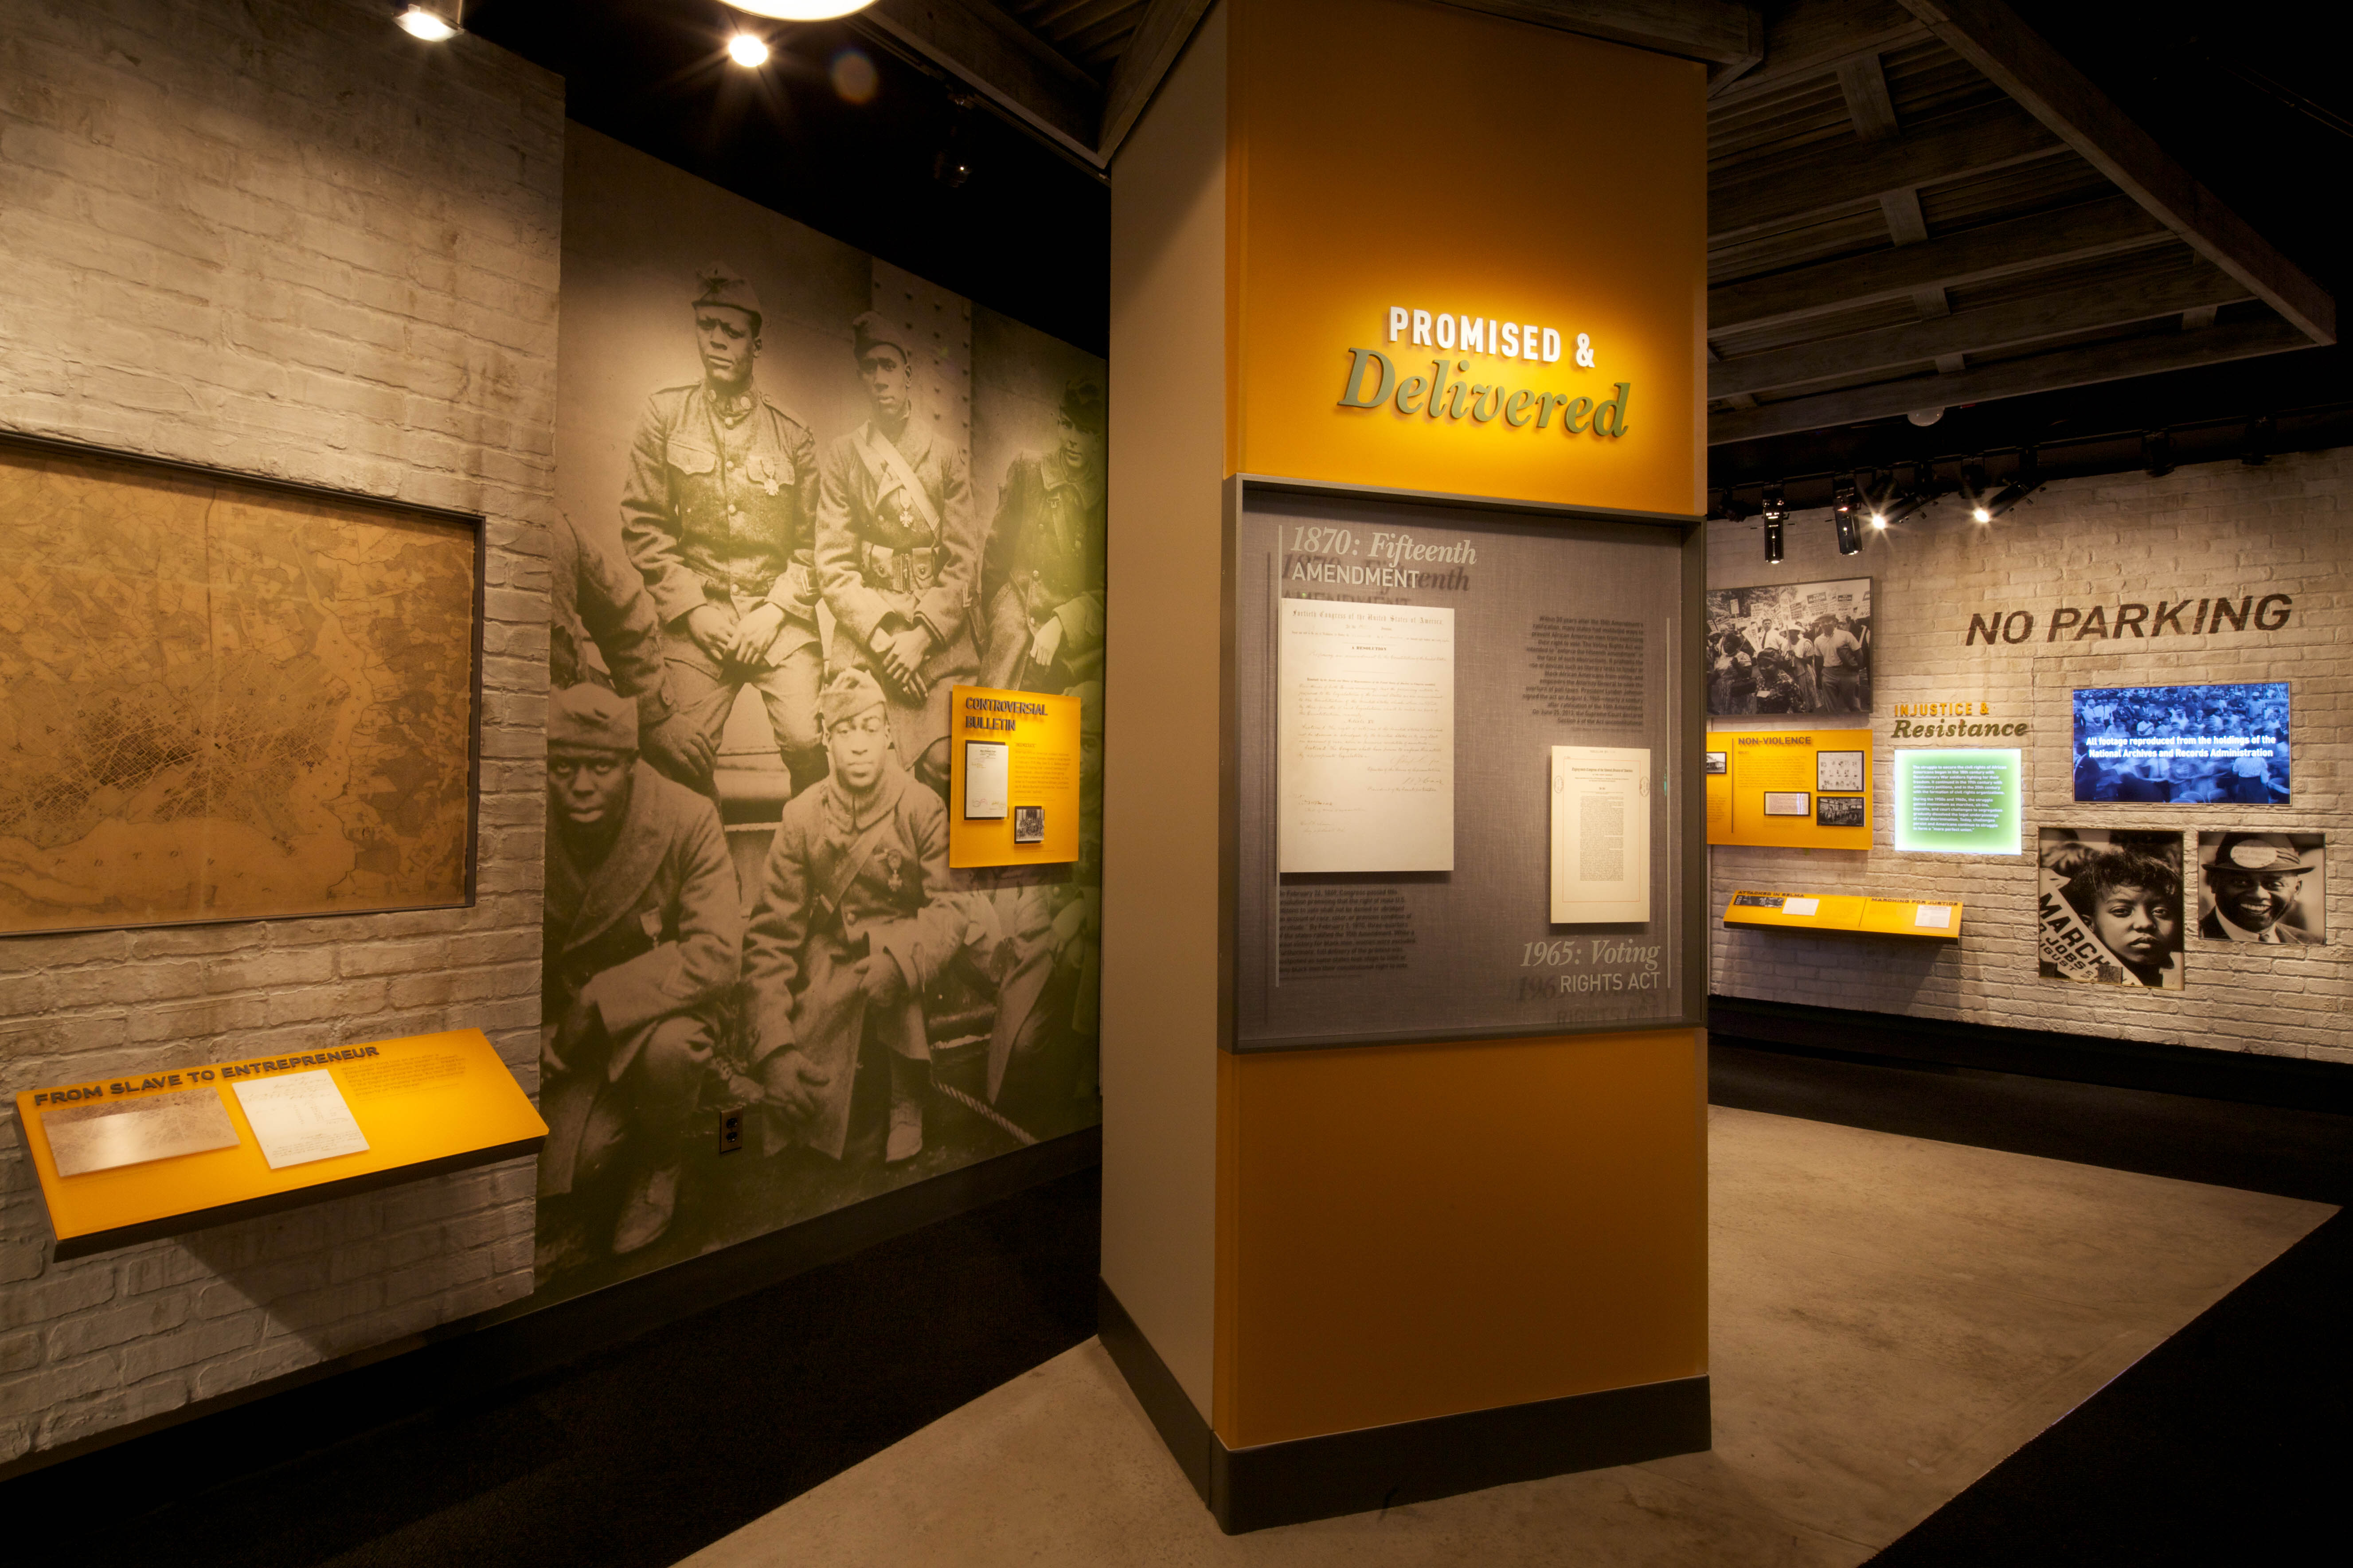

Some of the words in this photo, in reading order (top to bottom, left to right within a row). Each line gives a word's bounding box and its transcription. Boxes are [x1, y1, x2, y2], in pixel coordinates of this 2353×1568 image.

[1388, 306, 1560, 363] PROMISED
[1575, 333, 1595, 368] &
[1337, 347, 1631, 438] Delivered
[1290, 526, 1360, 555] 1870:
[1368, 532, 1477, 568] Fifteenth
[1292, 562, 1419, 588] AMENDMENT
[1966, 610, 2034, 646] NO
[2047, 594, 2293, 643] PARKING
[966, 697, 1048, 716] CONTROVERSIAL
[1894, 703, 1973, 717] INJUSTICE
[1980, 702, 1989, 716] &
[965, 716, 1016, 731] BULLETIN
[1891, 718, 2028, 738] Resistance
[1738, 736, 1812, 745] NON-VIOLENCE
[2099, 737, 2128, 747] footage
[2129, 736, 2175, 747] reproduced
[2213, 735, 2250, 746] holdings
[2251, 735, 2260, 744] of
[2262, 735, 2276, 744] the
[2123, 749, 2157, 757] Archives
[2175, 749, 2208, 757] Records
[2210, 748, 2273, 757] Administration
[2039, 892, 2111, 970] MARCH
[1520, 941, 1582, 966] 1965:
[1591, 938, 1661, 971] Voting
[2045, 937, 2086, 970] JOBS
[1560, 973, 1623, 993] RIGHTS
[1627, 972, 1661, 989] ACT
[34, 1086, 103, 1106] FROM
[109, 1074, 183, 1095] SLAVE
[187, 1069, 215, 1082] TO
[221, 1046, 379, 1078] ENTREPRENEUR
